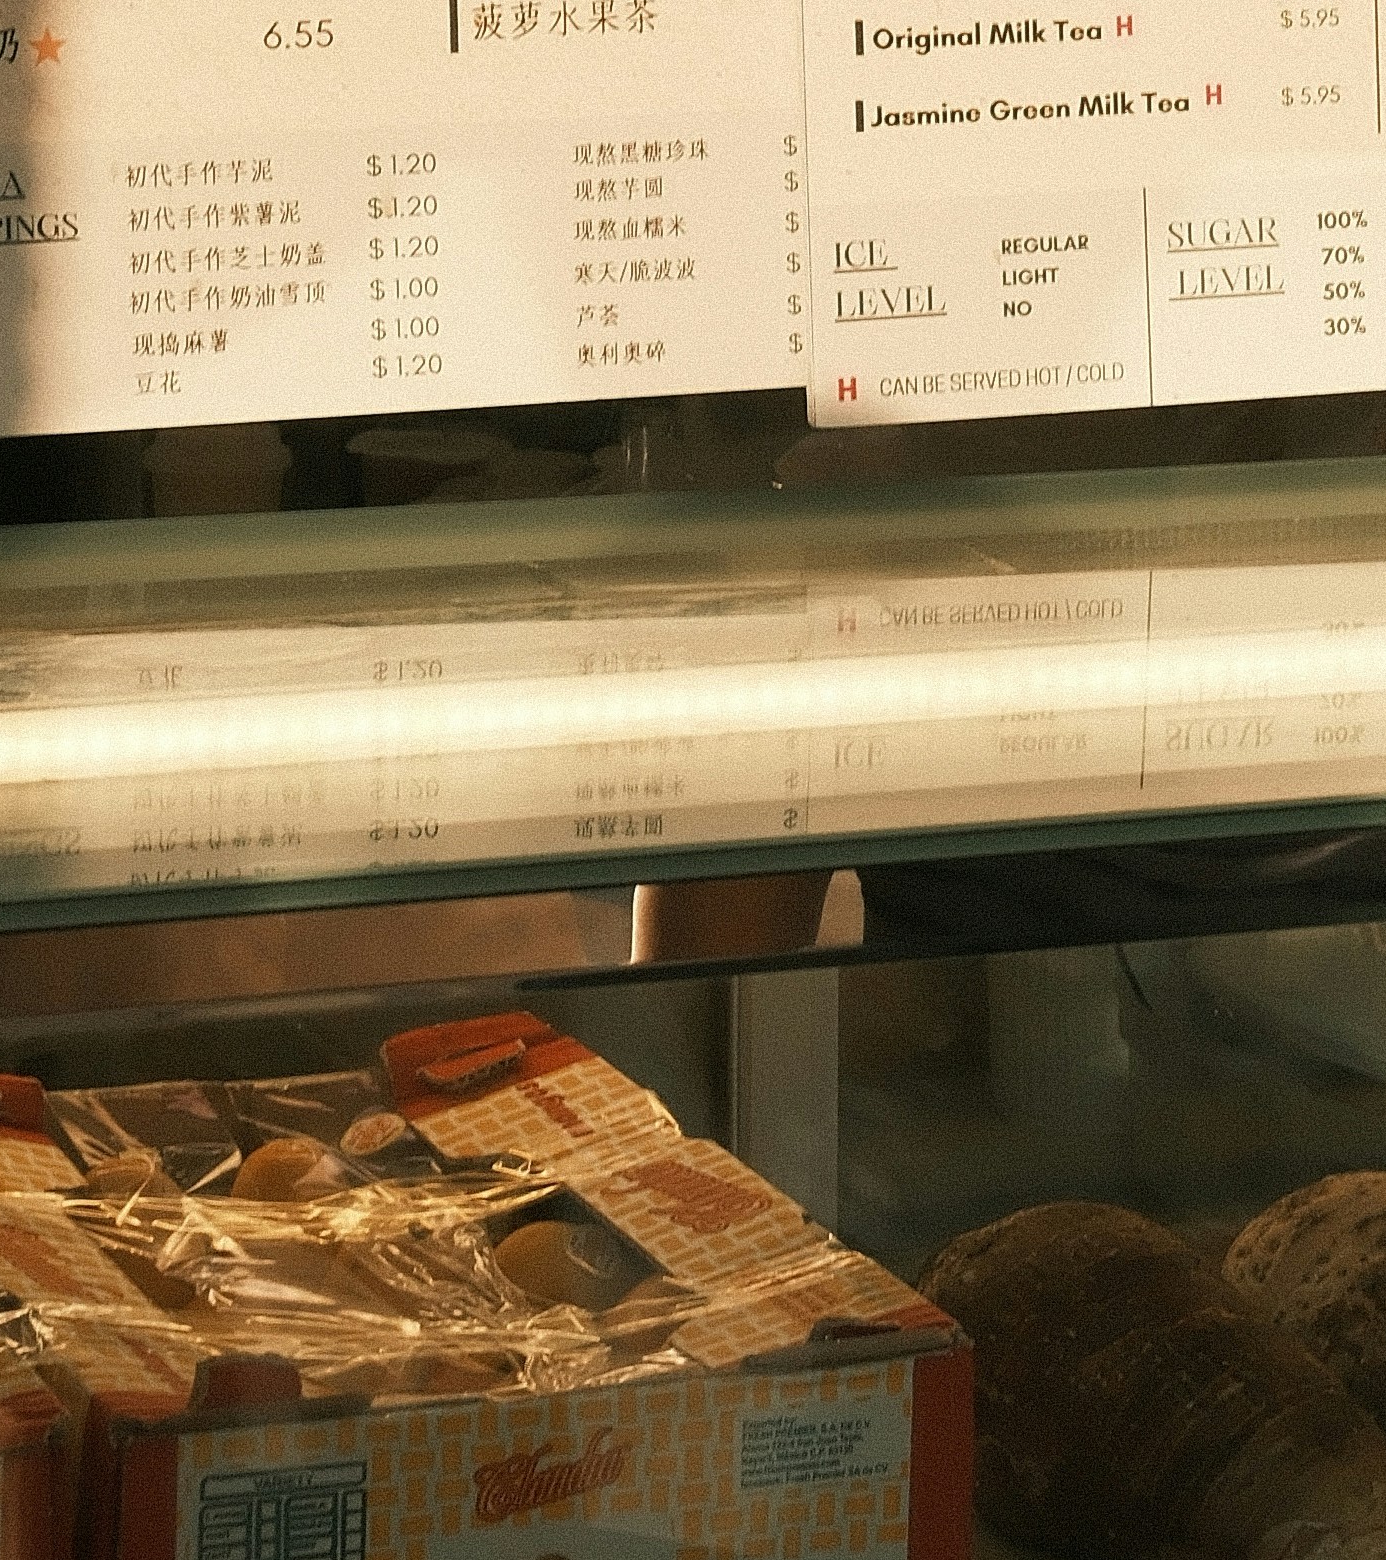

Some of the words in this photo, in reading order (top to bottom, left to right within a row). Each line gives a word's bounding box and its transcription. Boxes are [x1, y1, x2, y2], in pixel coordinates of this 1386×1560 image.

[263, 19, 334, 50] 6.55
[838, 377, 857, 401] H
[880, 377, 918, 397] CAN
[923, 374, 943, 394] BE
[950, 369, 1021, 392] SERVED
[1024, 366, 1060, 386] HOT
[1077, 363, 1124, 383] COLD
